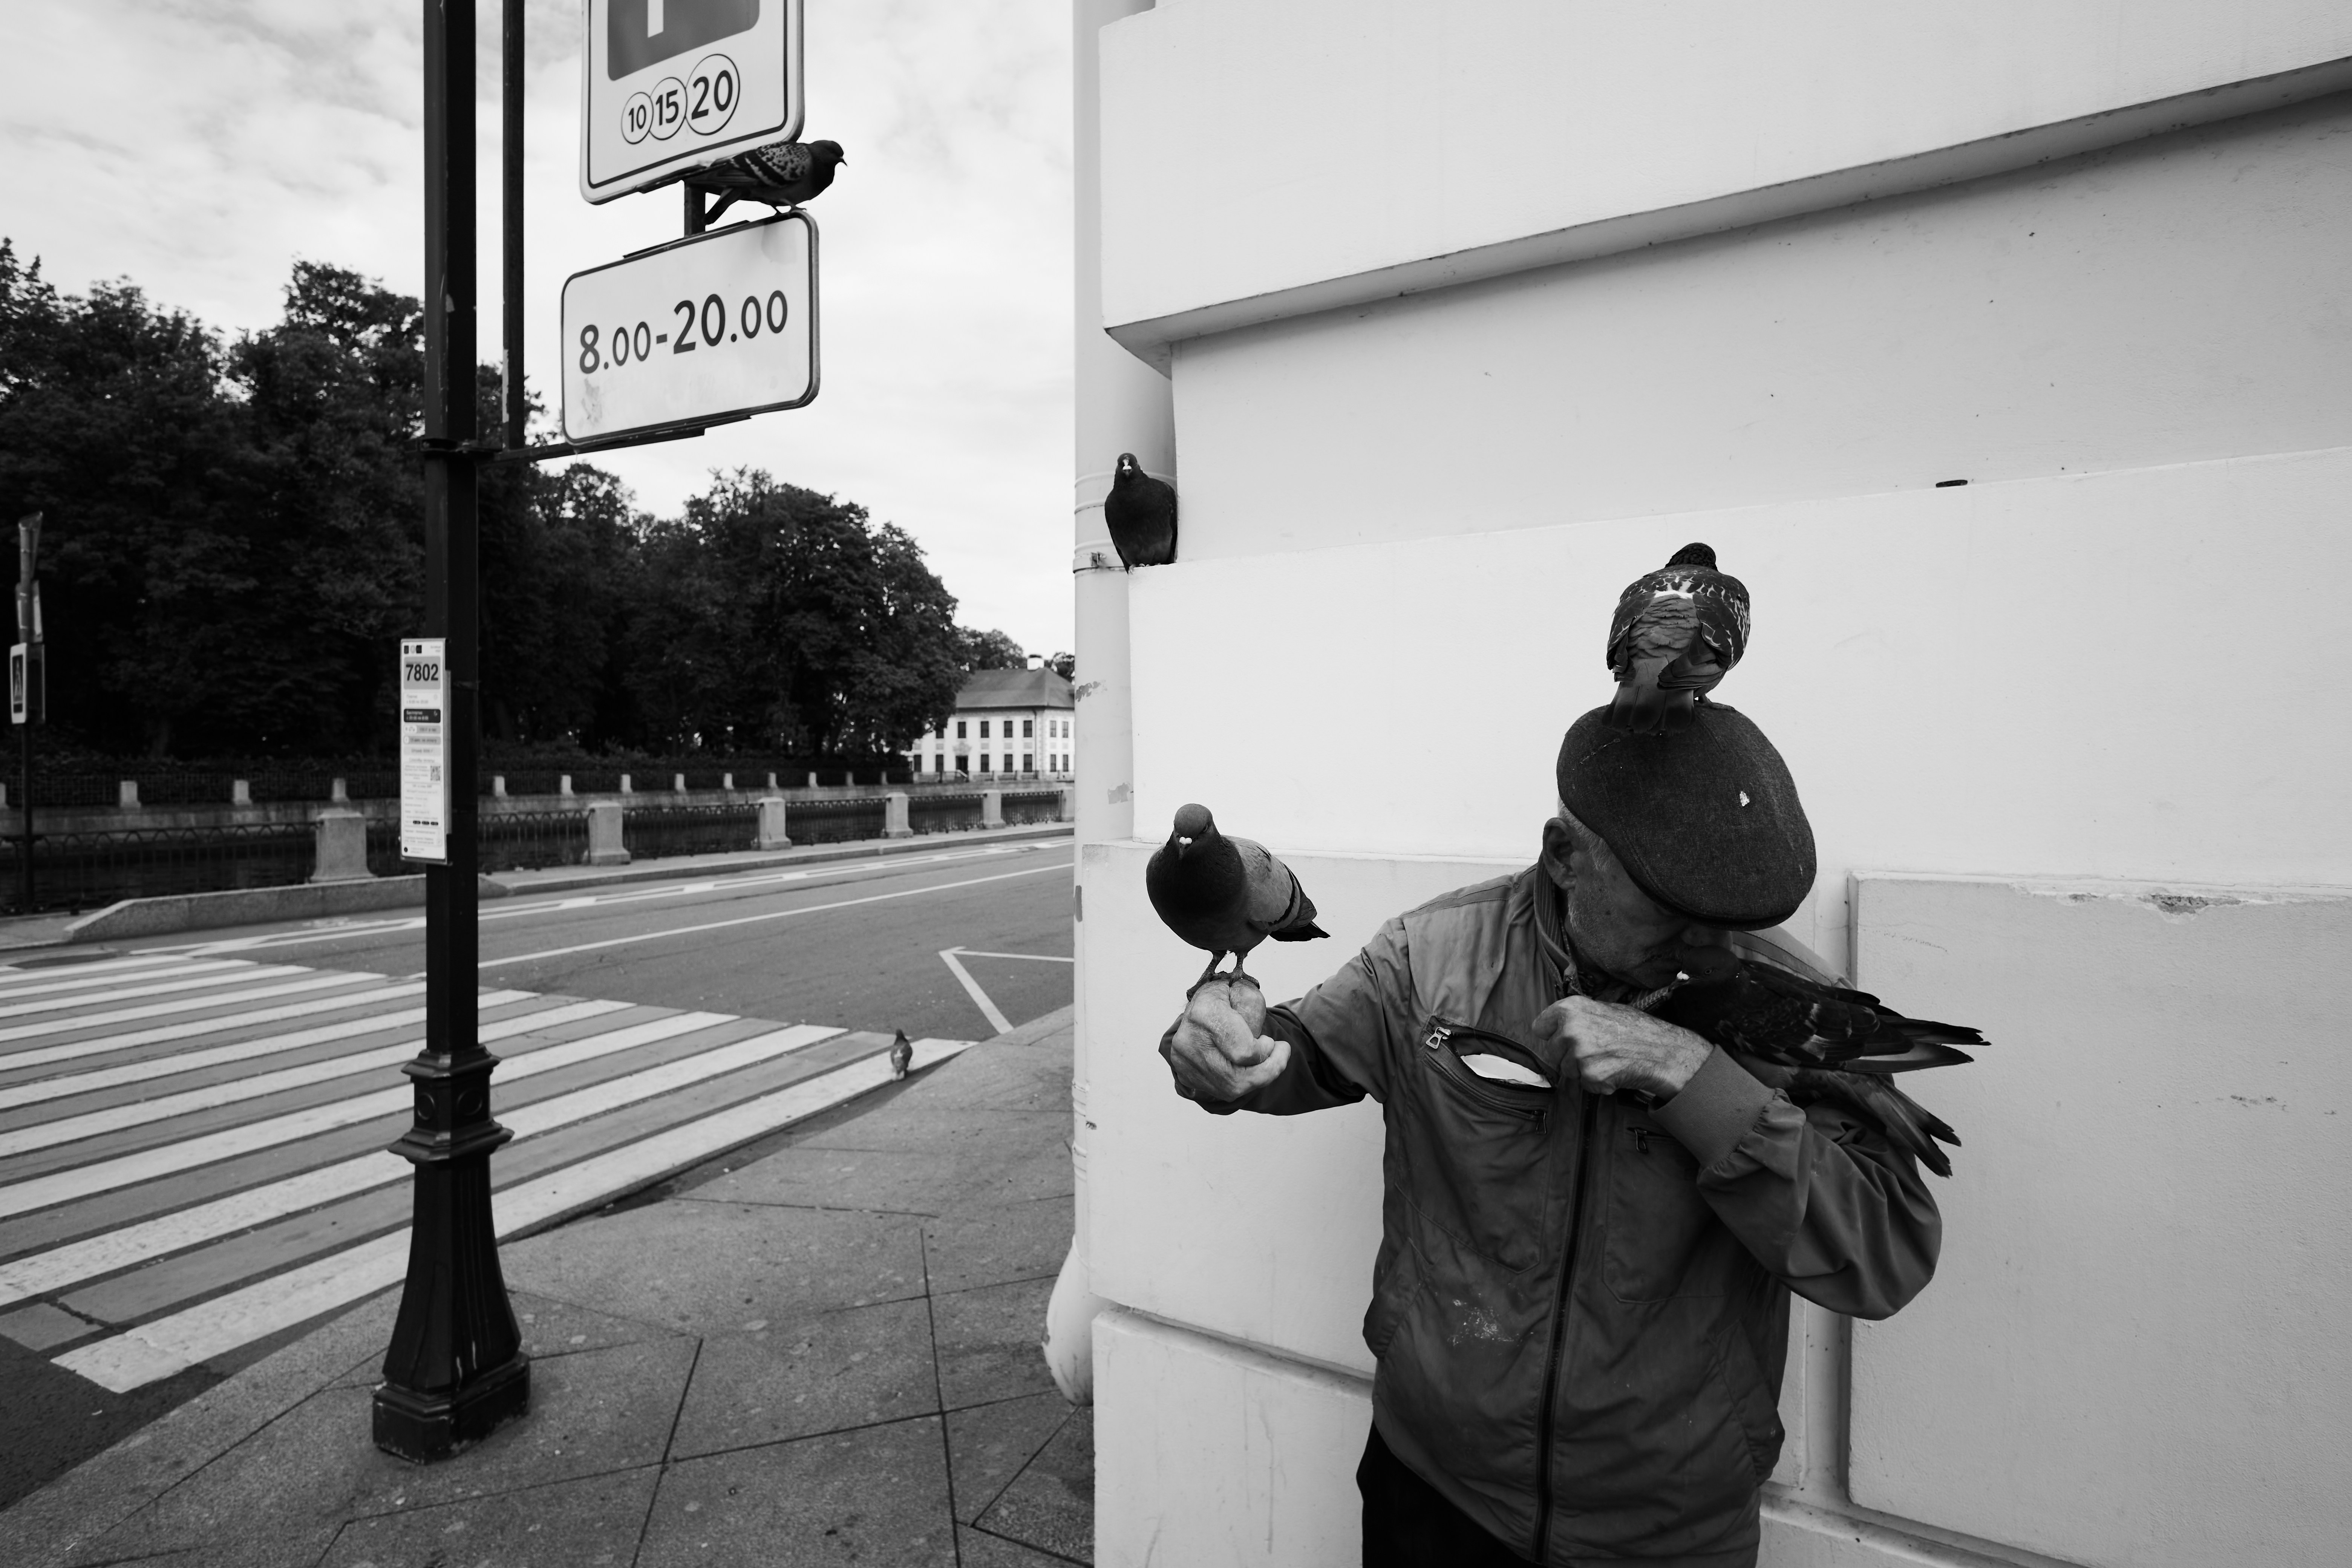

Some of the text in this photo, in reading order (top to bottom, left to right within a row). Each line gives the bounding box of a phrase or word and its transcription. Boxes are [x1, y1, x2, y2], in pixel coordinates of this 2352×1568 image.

[628, 70, 733, 132] 10 15 20
[579, 290, 788, 374] 8.00-20.00
[406, 663, 439, 681] 7802
